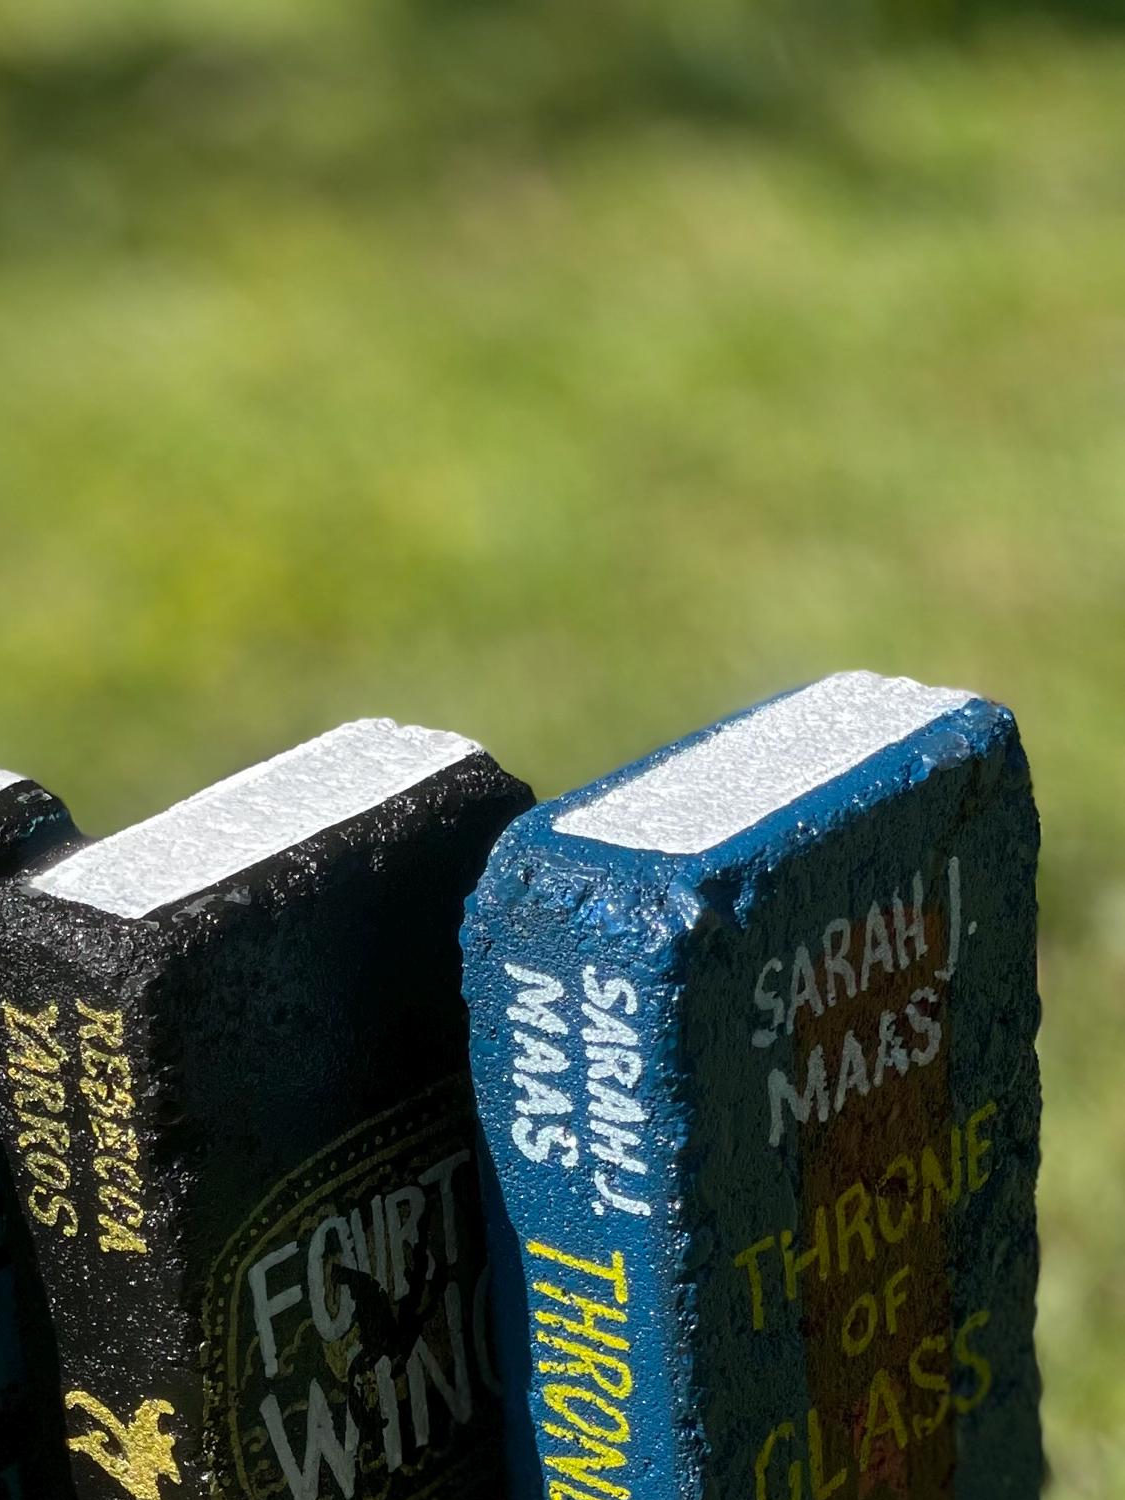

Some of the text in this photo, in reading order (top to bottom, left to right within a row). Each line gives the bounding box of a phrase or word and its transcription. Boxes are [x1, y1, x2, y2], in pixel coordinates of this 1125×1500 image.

[751, 856, 978, 1049] SARAH J.
[0, 999, 80, 1239] YARROS
[74, 998, 149, 1255] REBECCA
[505, 961, 580, 1169] MAAS
[580, 964, 648, 1177] SARAH
[766, 986, 943, 1149] MAAS
[734, 1099, 999, 1331] THRONE
[842, 1263, 913, 1358] OF
